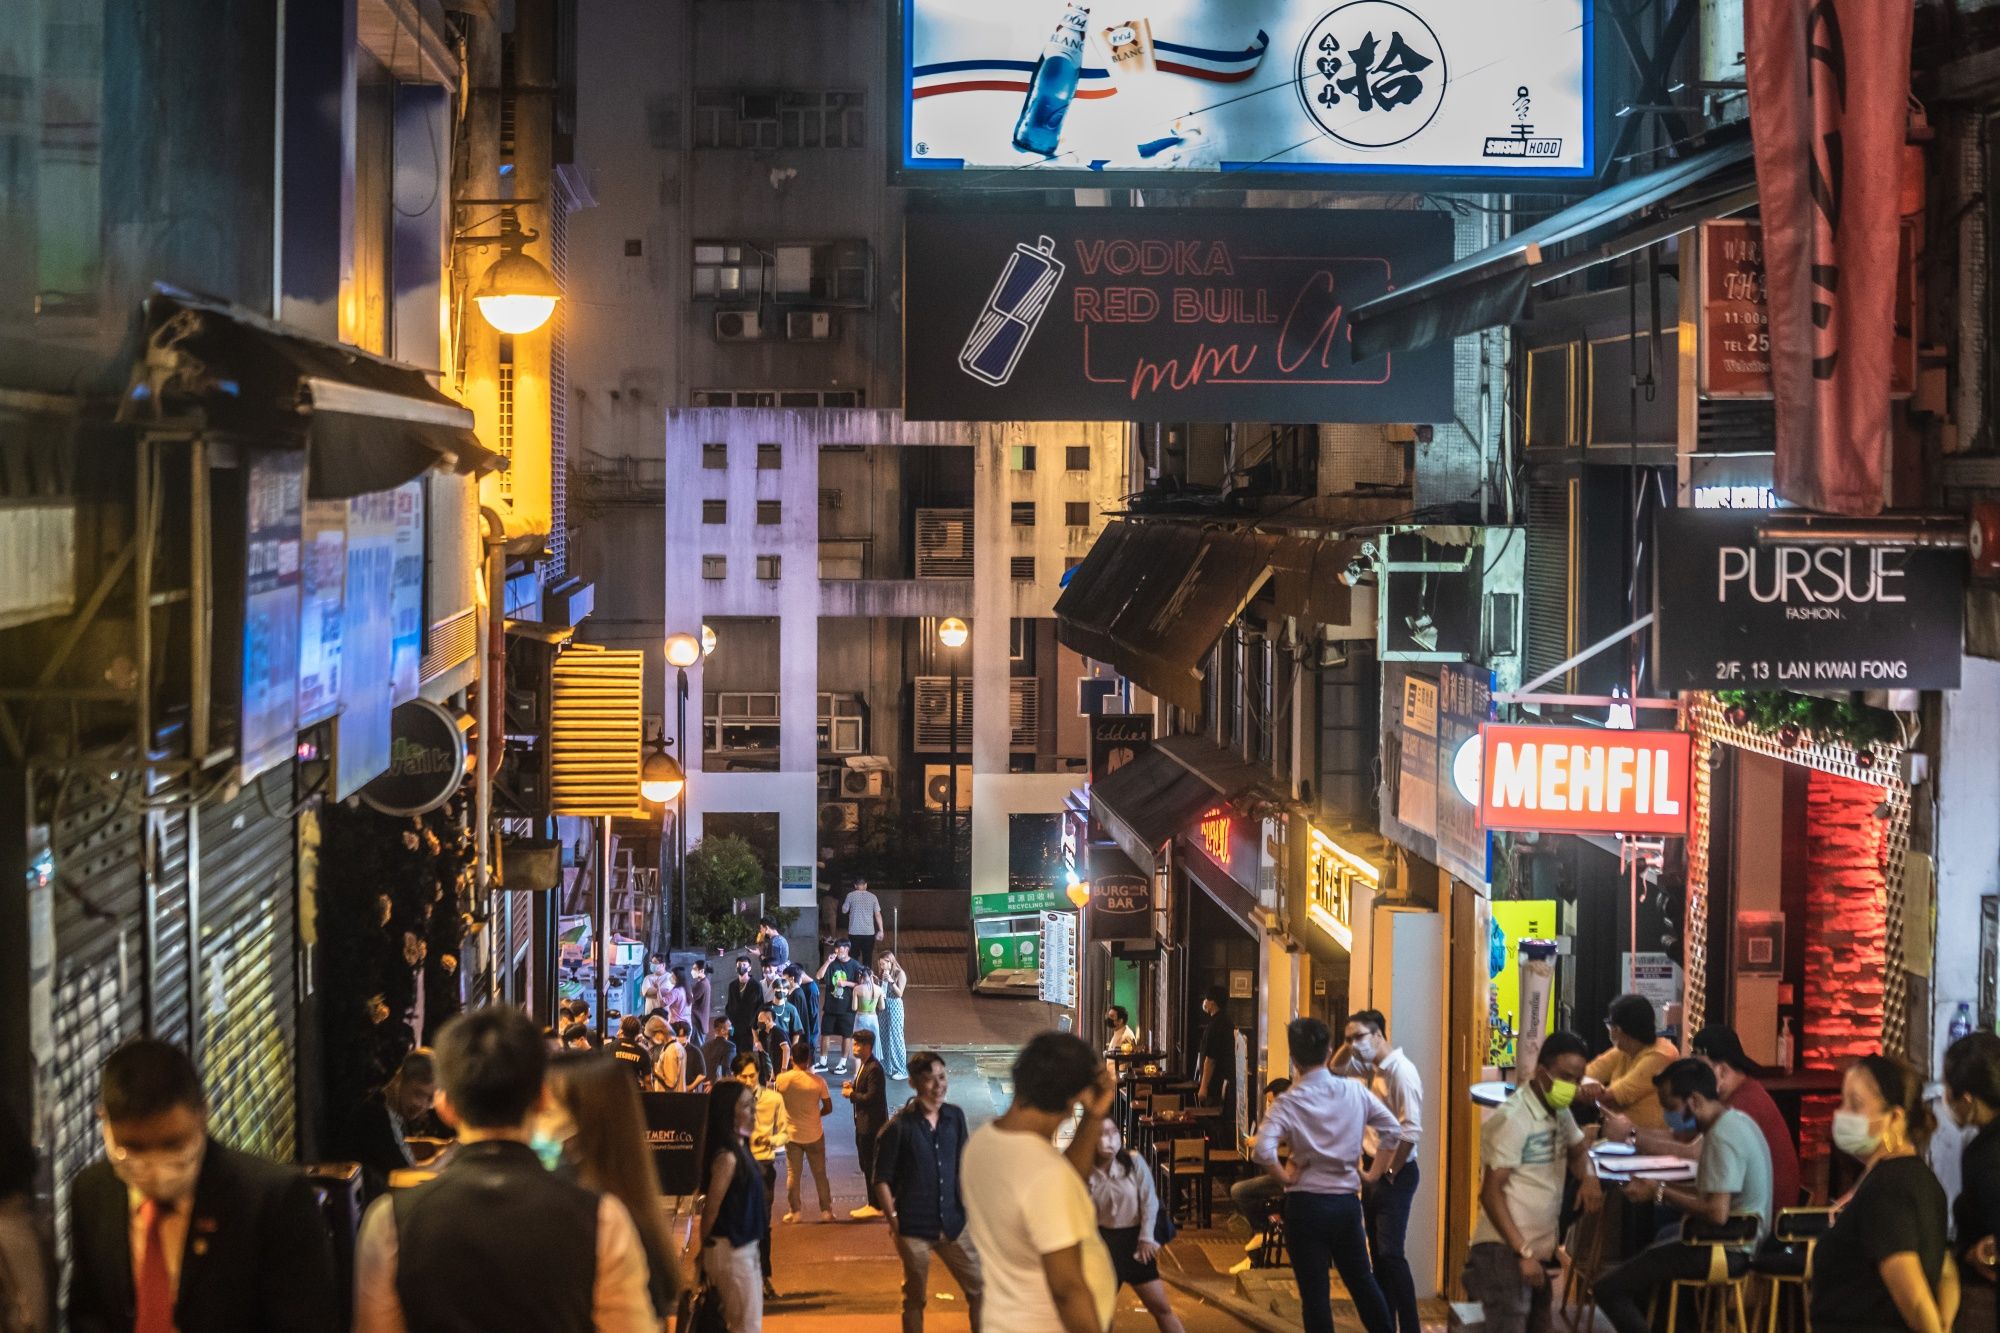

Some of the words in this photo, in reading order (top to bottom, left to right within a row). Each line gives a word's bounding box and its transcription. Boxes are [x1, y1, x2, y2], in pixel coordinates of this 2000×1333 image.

[1111, 46, 1145, 63] BLANC
[1336, 30, 1434, 112] 拾
[1529, 141, 1558, 155] HOOD
[1074, 240, 1235, 275] VODKA
[1724, 239, 1763, 265] WAR
[1723, 271, 1768, 305] THA
[1073, 287, 1160, 323] RED
[1173, 288, 1279, 324] BULL
[1724, 312, 1768, 325] 11:00a
[1747, 333, 1770, 352] 25
[1718, 546, 1907, 603] PURSUE
[1786, 607, 1841, 620] FASHION
[1751, 662, 1770, 680] 13
[1777, 661, 1811, 680] LAN
[1814, 661, 1857, 680] KWAI
[1860, 661, 1908, 680] FONG
[1491, 742, 1680, 815] MEHFIL
[1007, 902, 1044, 910] RECYCLING
[1107, 897, 1135, 909] BAR
